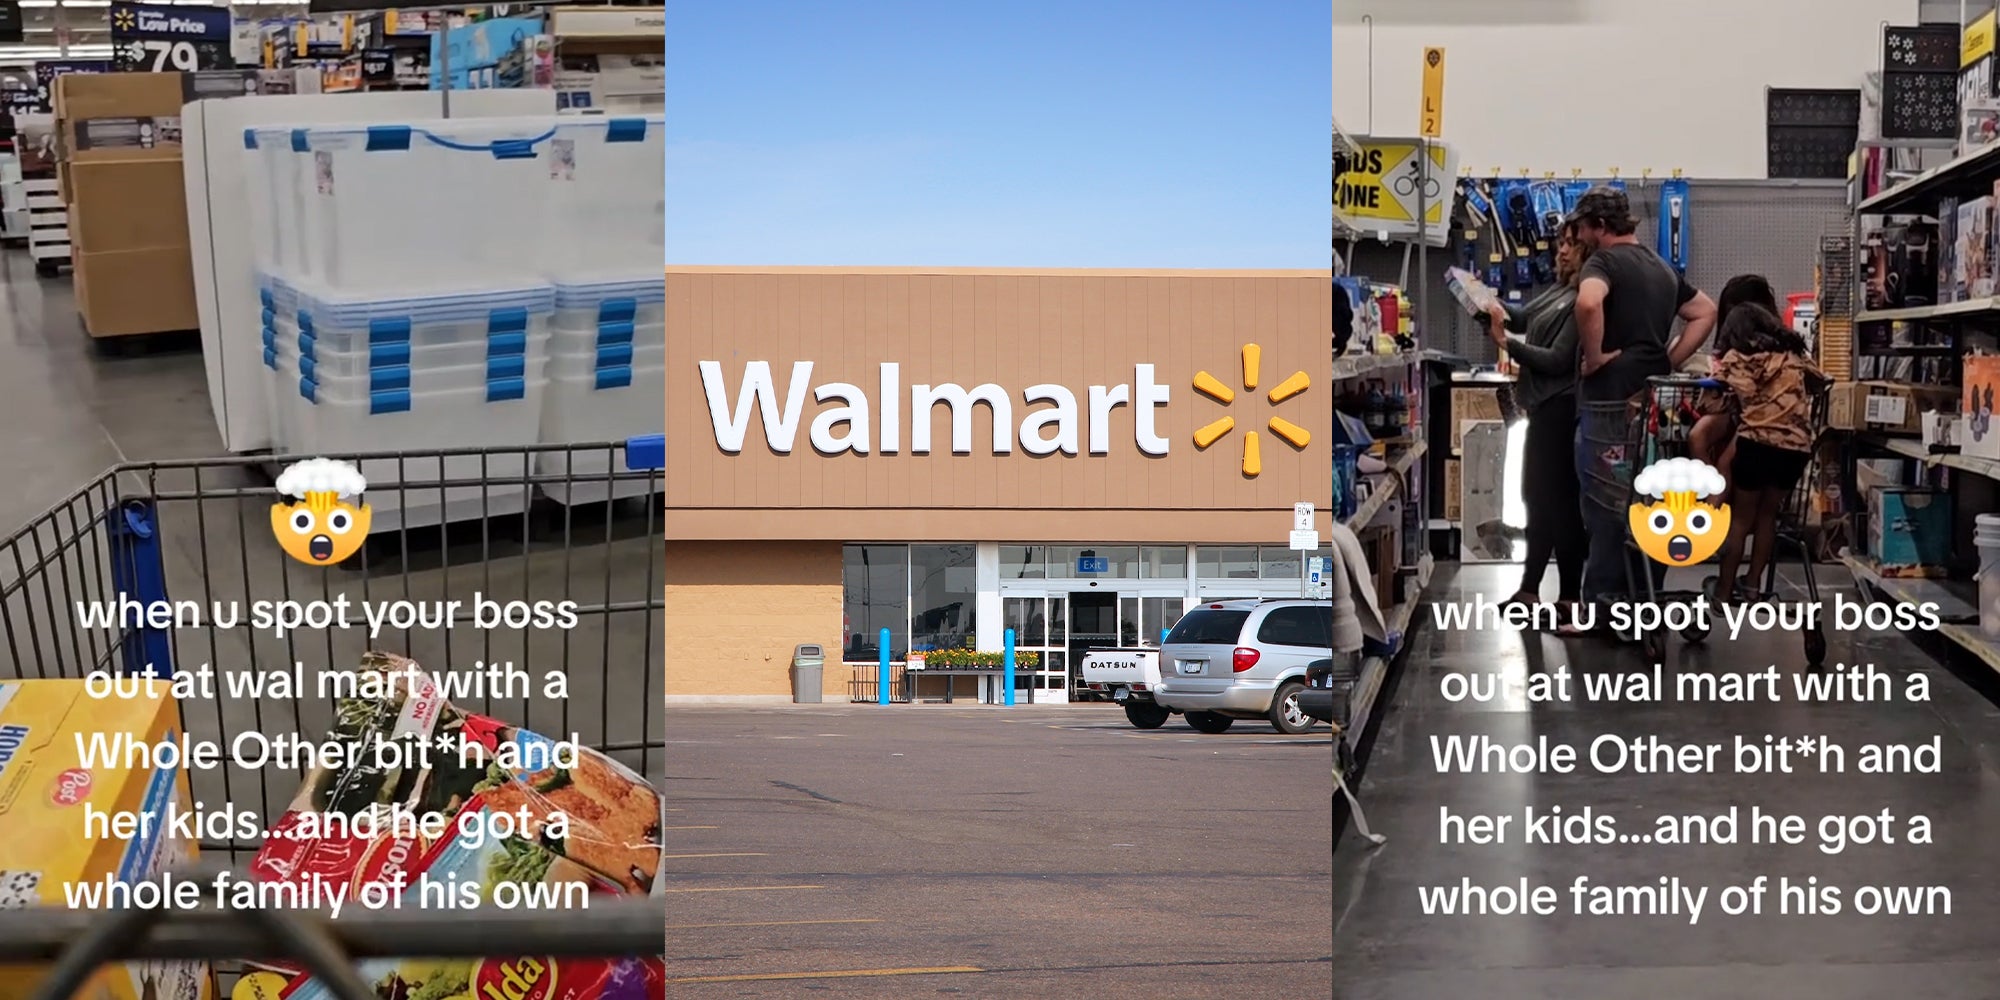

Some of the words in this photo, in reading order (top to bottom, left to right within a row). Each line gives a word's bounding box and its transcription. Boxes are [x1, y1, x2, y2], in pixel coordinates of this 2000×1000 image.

[138, 17, 169, 32] Low
[170, 18, 206, 34] Price
[699, 360, 1170, 456] Walmart
[1297, 507, 1311, 516] ROW
[1301, 518, 1307, 527] 4
[1083, 560, 1102, 570] Exit
[1090, 661, 1137, 669] DATSUN
[412, 700, 428, 720] NO
[60, 771, 91, 803] Post
